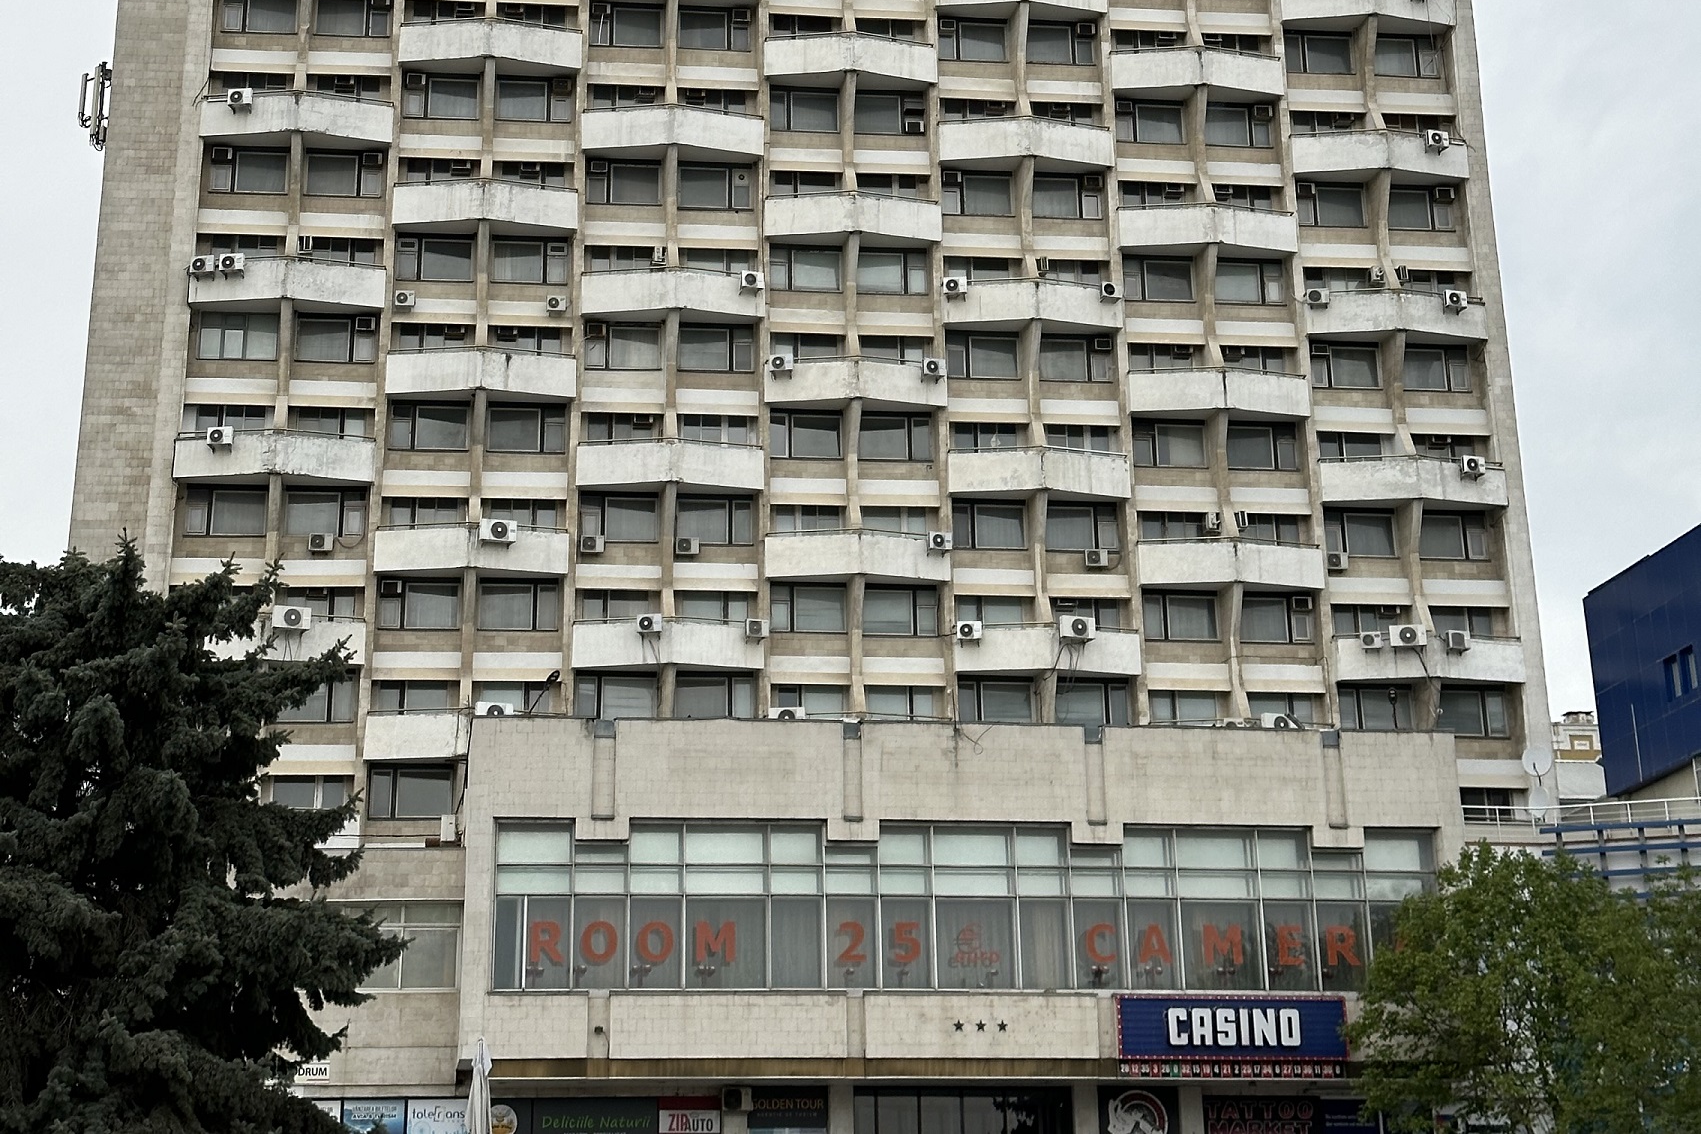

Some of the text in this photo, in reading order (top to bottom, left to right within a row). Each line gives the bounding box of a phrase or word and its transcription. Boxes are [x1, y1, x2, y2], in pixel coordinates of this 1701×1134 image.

[531, 920, 737, 964] ROOM
[838, 921, 921, 964] 25
[1167, 1007, 1301, 1047] CASINO
[1173, 1063, 1178, 1074] 0
[1214, 1063, 1220, 1074] 4
[1223, 1064, 1231, 1074] 21
[1234, 1064, 1239, 1074] 2
[1254, 1064, 1261, 1074] 17
[1283, 1064, 1292, 1074] 27
[1294, 1064, 1301, 1074] 13
[1314, 1064, 1321, 1074] 11
[795, 1099, 824, 1110] TOUR
[1204, 1100, 1314, 1119] TATTOO
[542, 1115, 651, 1129] Deliciile Naturii
[1208, 1120, 1313, 1134] MARKET
